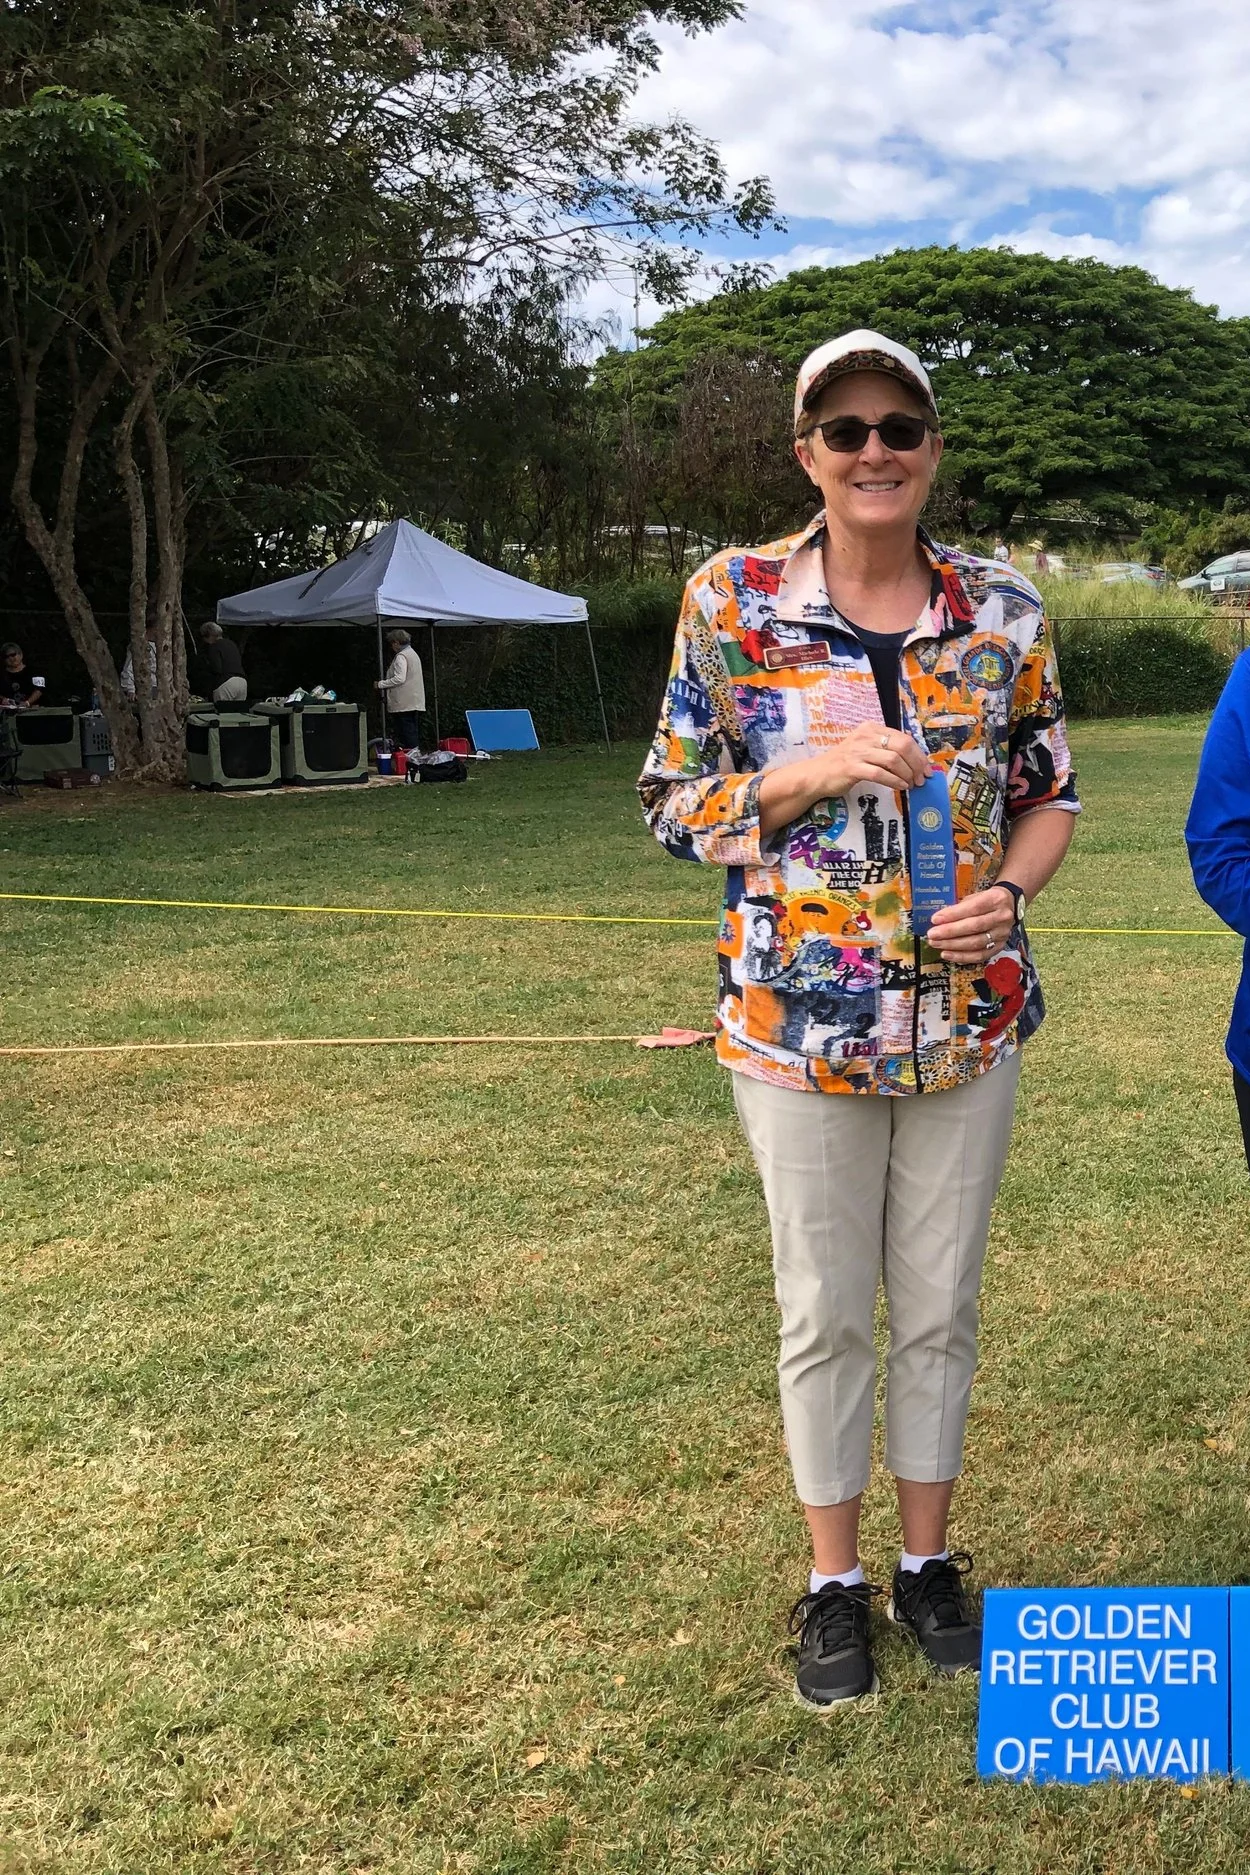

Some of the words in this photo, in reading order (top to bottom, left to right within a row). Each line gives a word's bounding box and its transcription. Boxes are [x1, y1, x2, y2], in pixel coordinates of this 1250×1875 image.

[919, 842, 944, 851] Golden
[918, 861, 935, 870] Club
[1017, 1604, 1191, 1641] GOLDEN
[990, 1649, 1217, 1685] RETRIEVER
[1051, 1693, 1160, 1730] CLUB
[994, 1737, 1053, 1775] OF
[1066, 1738, 1210, 1774] HAWAII
